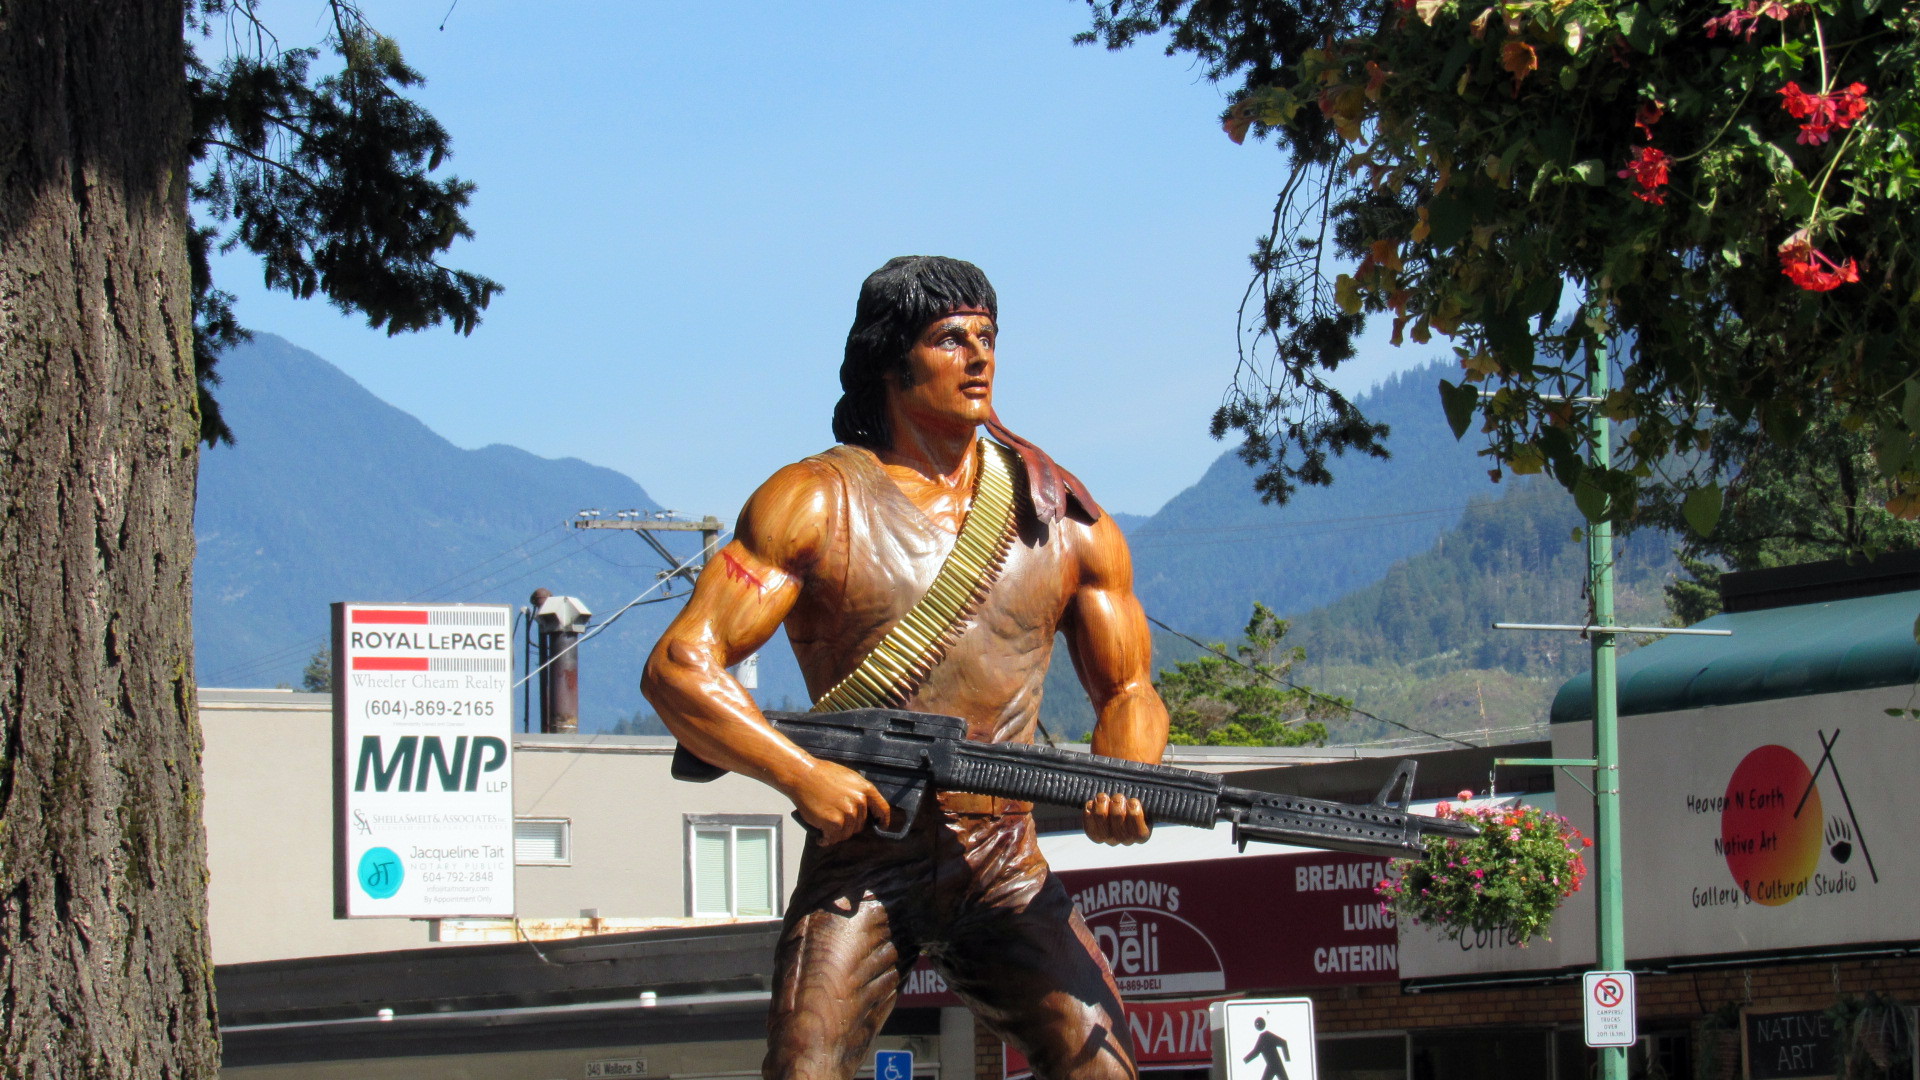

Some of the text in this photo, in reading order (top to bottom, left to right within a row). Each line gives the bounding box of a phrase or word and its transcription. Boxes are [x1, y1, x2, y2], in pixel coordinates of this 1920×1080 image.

[352, 631, 425, 649] ROYAL
[352, 673, 506, 693] Wheeler Cheam Realty
[365, 700, 494, 719] (604)-869-2165
[354, 735, 508, 792] MNP
[486, 781, 508, 793] LLP
[1687, 786, 1785, 814] Heaven N Earth
[442, 814, 497, 824] ASSOCIATES
[410, 845, 505, 861] Jacqueline Tait
[1714, 831, 1778, 856] Native Art
[410, 862, 505, 871] NOTARY PUBLIC
[422, 871, 494, 882] 604-792-2848
[1295, 862, 1399, 892] BREAKFAS
[433, 895, 476, 904] Appointment
[477, 895, 493, 904] Only
[1071, 879, 1180, 914] SHARRON'S
[1692, 886, 1739, 909] Gallery
[1757, 876, 1809, 900] Cultural
[1814, 870, 1857, 896] Studio
[1343, 903, 1397, 931] LUNC
[1094, 922, 1159, 974] Deli
[1460, 918, 1531, 952] Coffe
[1314, 944, 1399, 973] CATERIN
[903, 969, 948, 995] AIRS
[1129, 1008, 1210, 1054] NAIR
[1757, 1015, 1830, 1043] NATIVE
[604, 1062, 632, 1075] Wallace
[1777, 1043, 1817, 1071] ART
